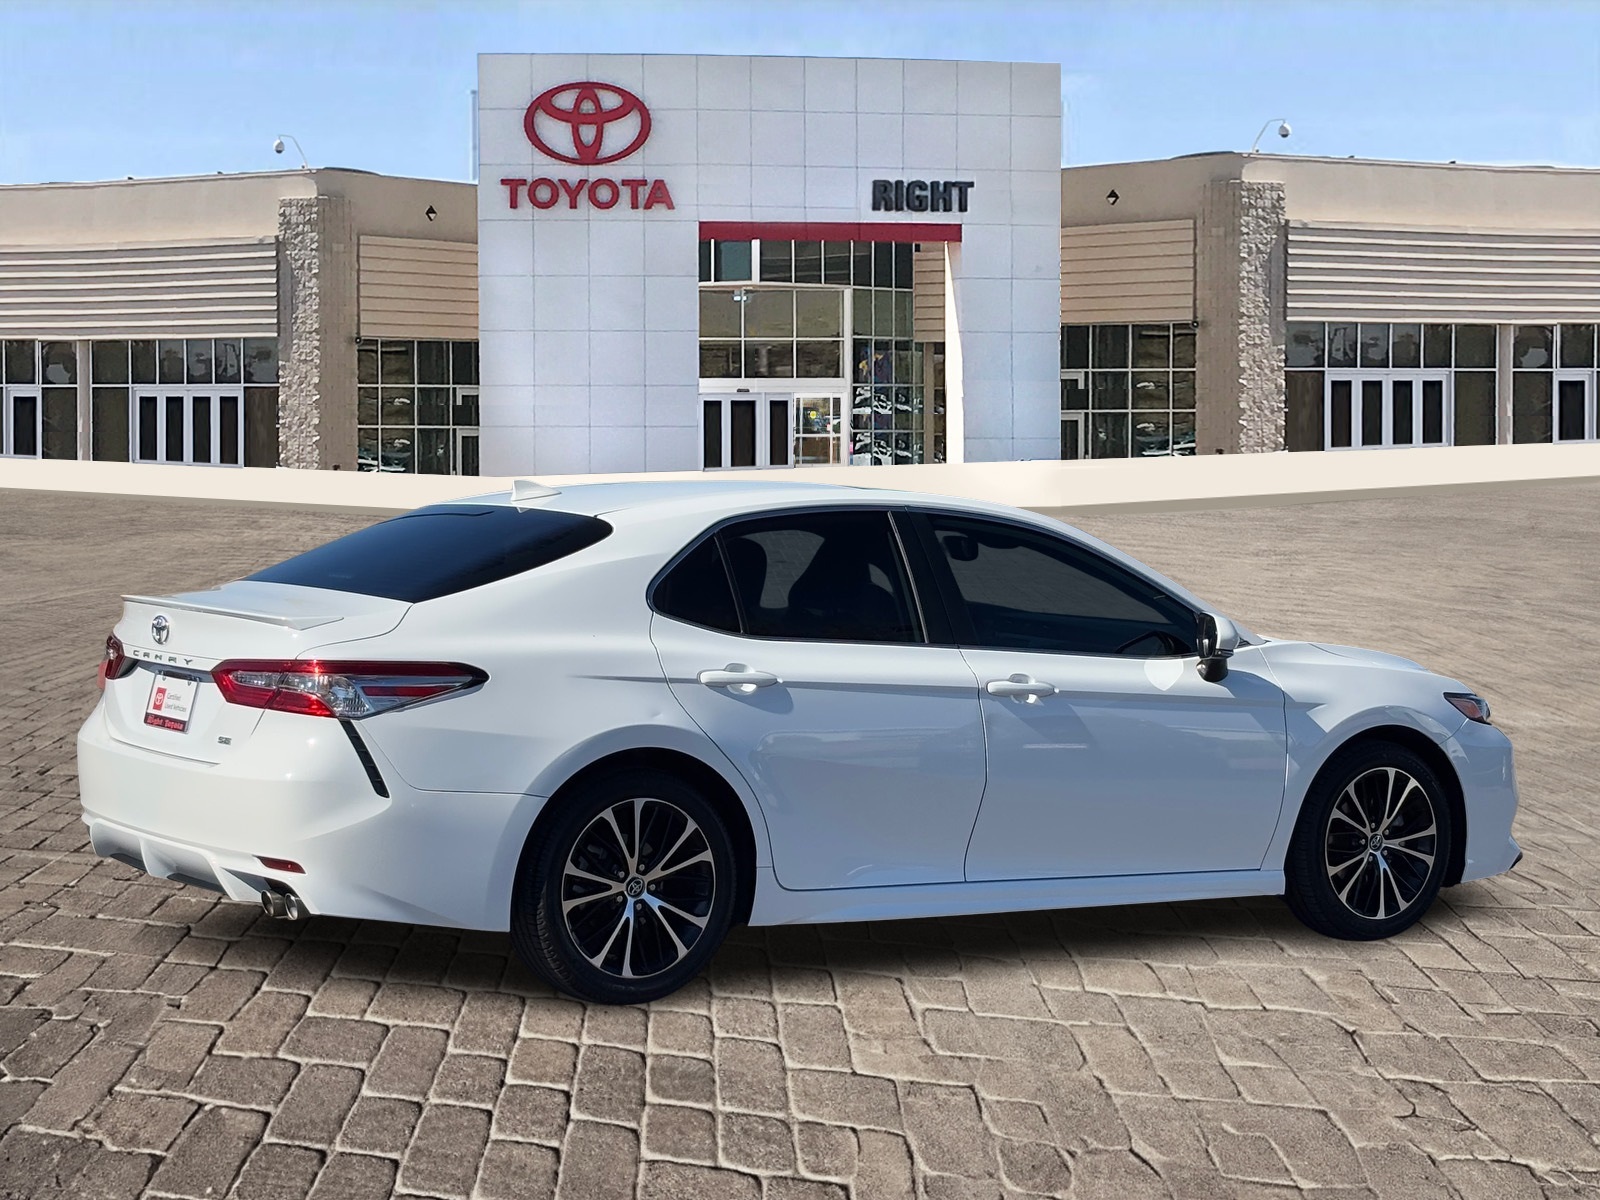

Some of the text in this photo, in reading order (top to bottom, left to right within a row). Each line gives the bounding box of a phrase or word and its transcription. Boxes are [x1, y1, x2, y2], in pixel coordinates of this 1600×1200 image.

[501, 178, 675, 210] TOYOTA
[872, 179, 975, 213] RIGHT
[132, 649, 193, 665] CAMRY
[217, 736, 232, 745] SE
